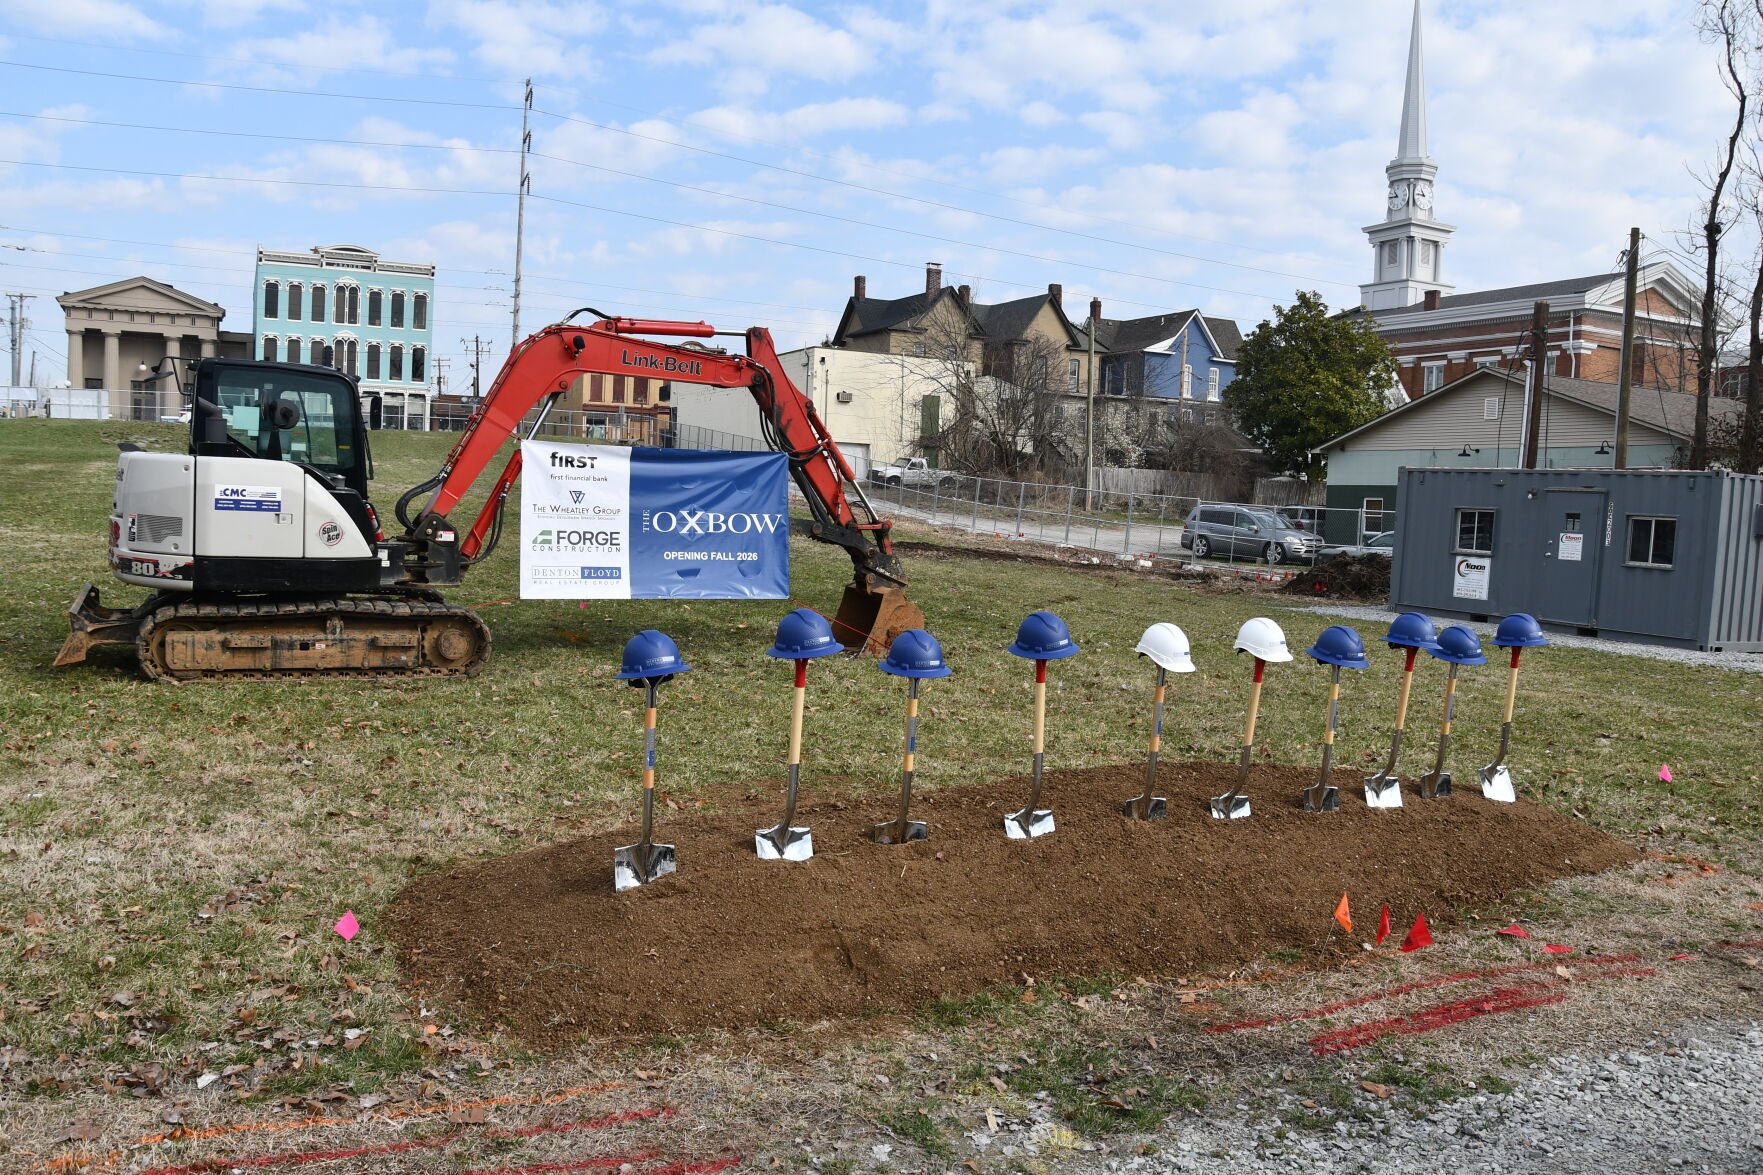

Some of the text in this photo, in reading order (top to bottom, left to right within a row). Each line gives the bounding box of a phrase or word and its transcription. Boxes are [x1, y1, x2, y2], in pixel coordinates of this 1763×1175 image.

[622, 349, 703, 375] Link-Belt
[223, 488, 247, 497] CMC
[532, 503, 621, 515] THE WHEATLEY GROUP
[642, 509, 650, 533] THE
[652, 510, 782, 534] OXBOW
[322, 524, 338, 535] Spin
[326, 533, 340, 542] Ace
[556, 530, 621, 546] FORGE
[532, 545, 621, 553] CONSTRUCTION
[663, 551, 758, 561] OPENING FALL 2026
[534, 568, 620, 577] DENTON FLOYD
